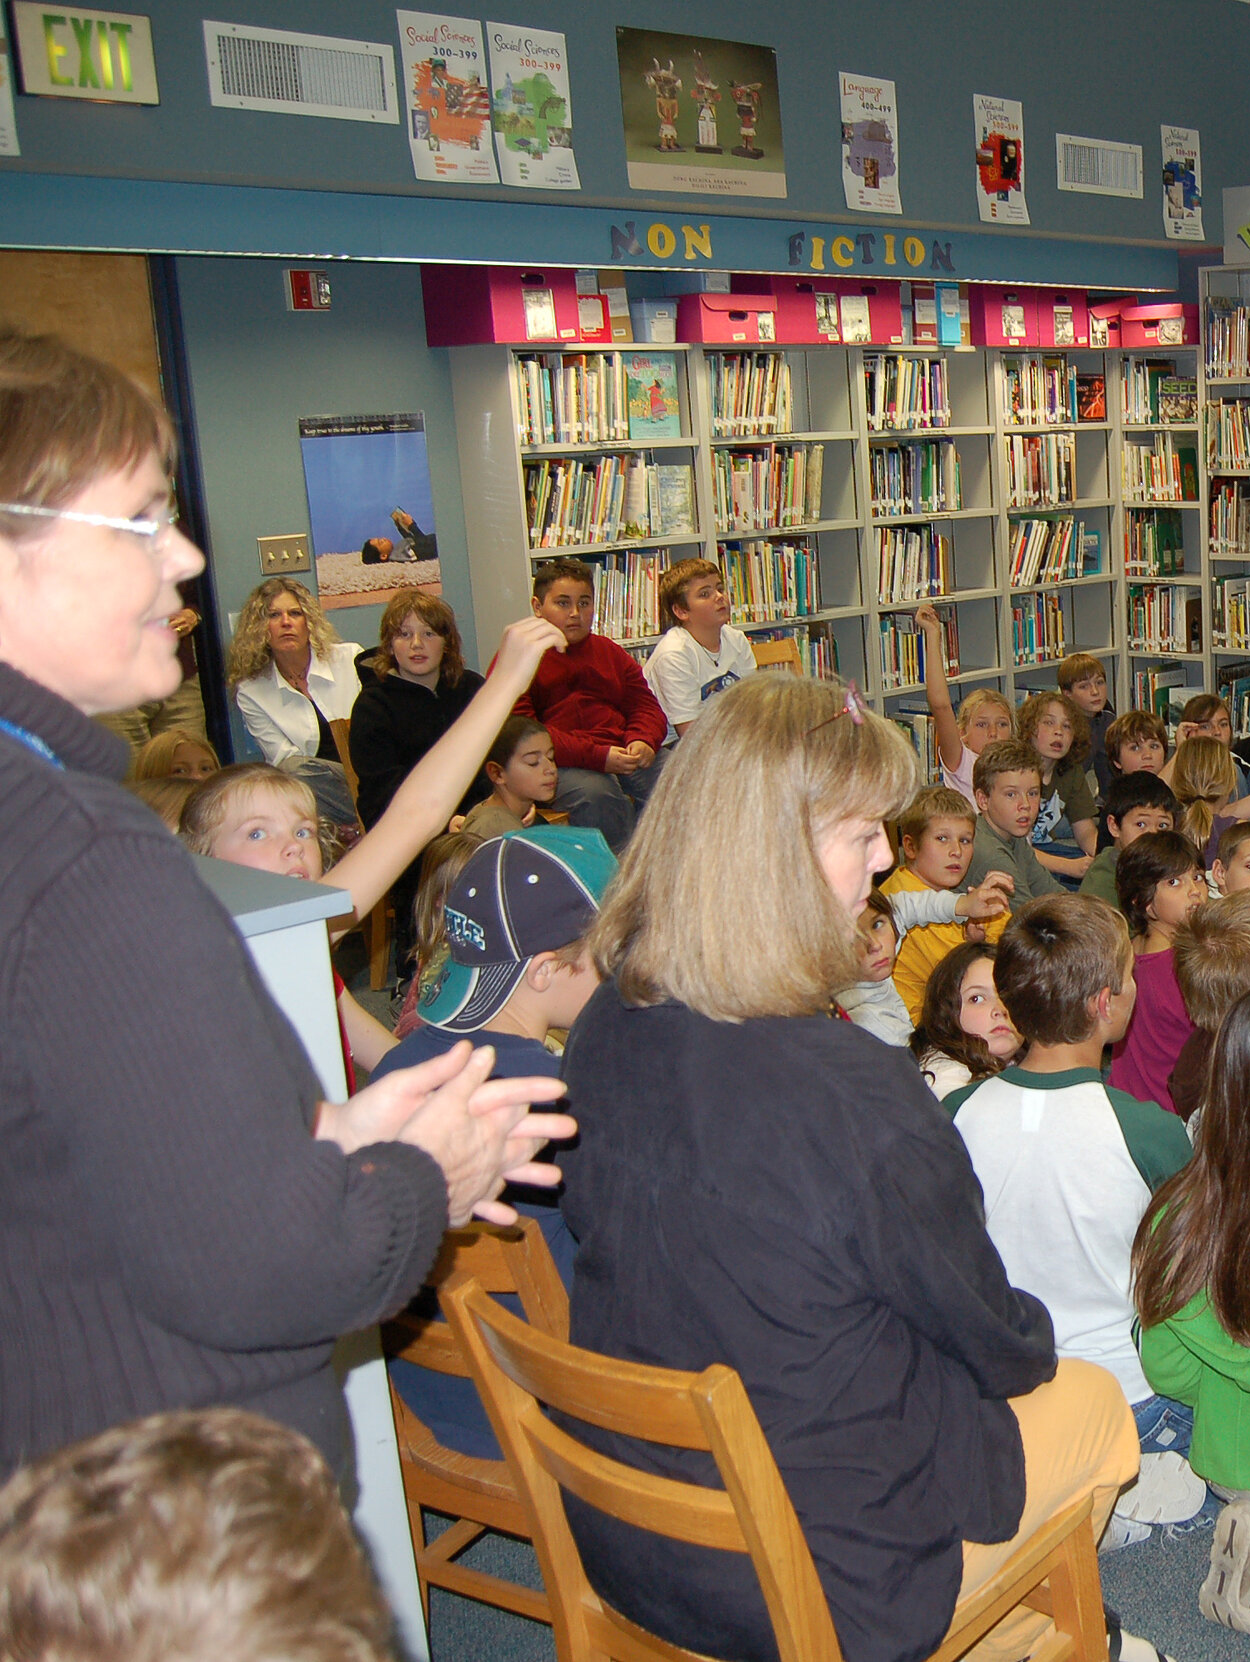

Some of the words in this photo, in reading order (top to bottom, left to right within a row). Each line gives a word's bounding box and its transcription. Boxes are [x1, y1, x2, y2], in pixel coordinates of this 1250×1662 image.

[406, 26, 439, 46] Social
[440, 24, 476, 48] Sciences
[493, 33, 522, 53] Social
[524, 39, 561, 58] Sciences
[42, 13, 133, 92] EXIT
[432, 46, 478, 60] 300-399
[519, 57, 561, 72] 300-399
[842, 76, 882, 102] Language
[861, 102, 892, 112] 400-499
[610, 221, 713, 260] NON
[788, 232, 956, 272] FICTION
